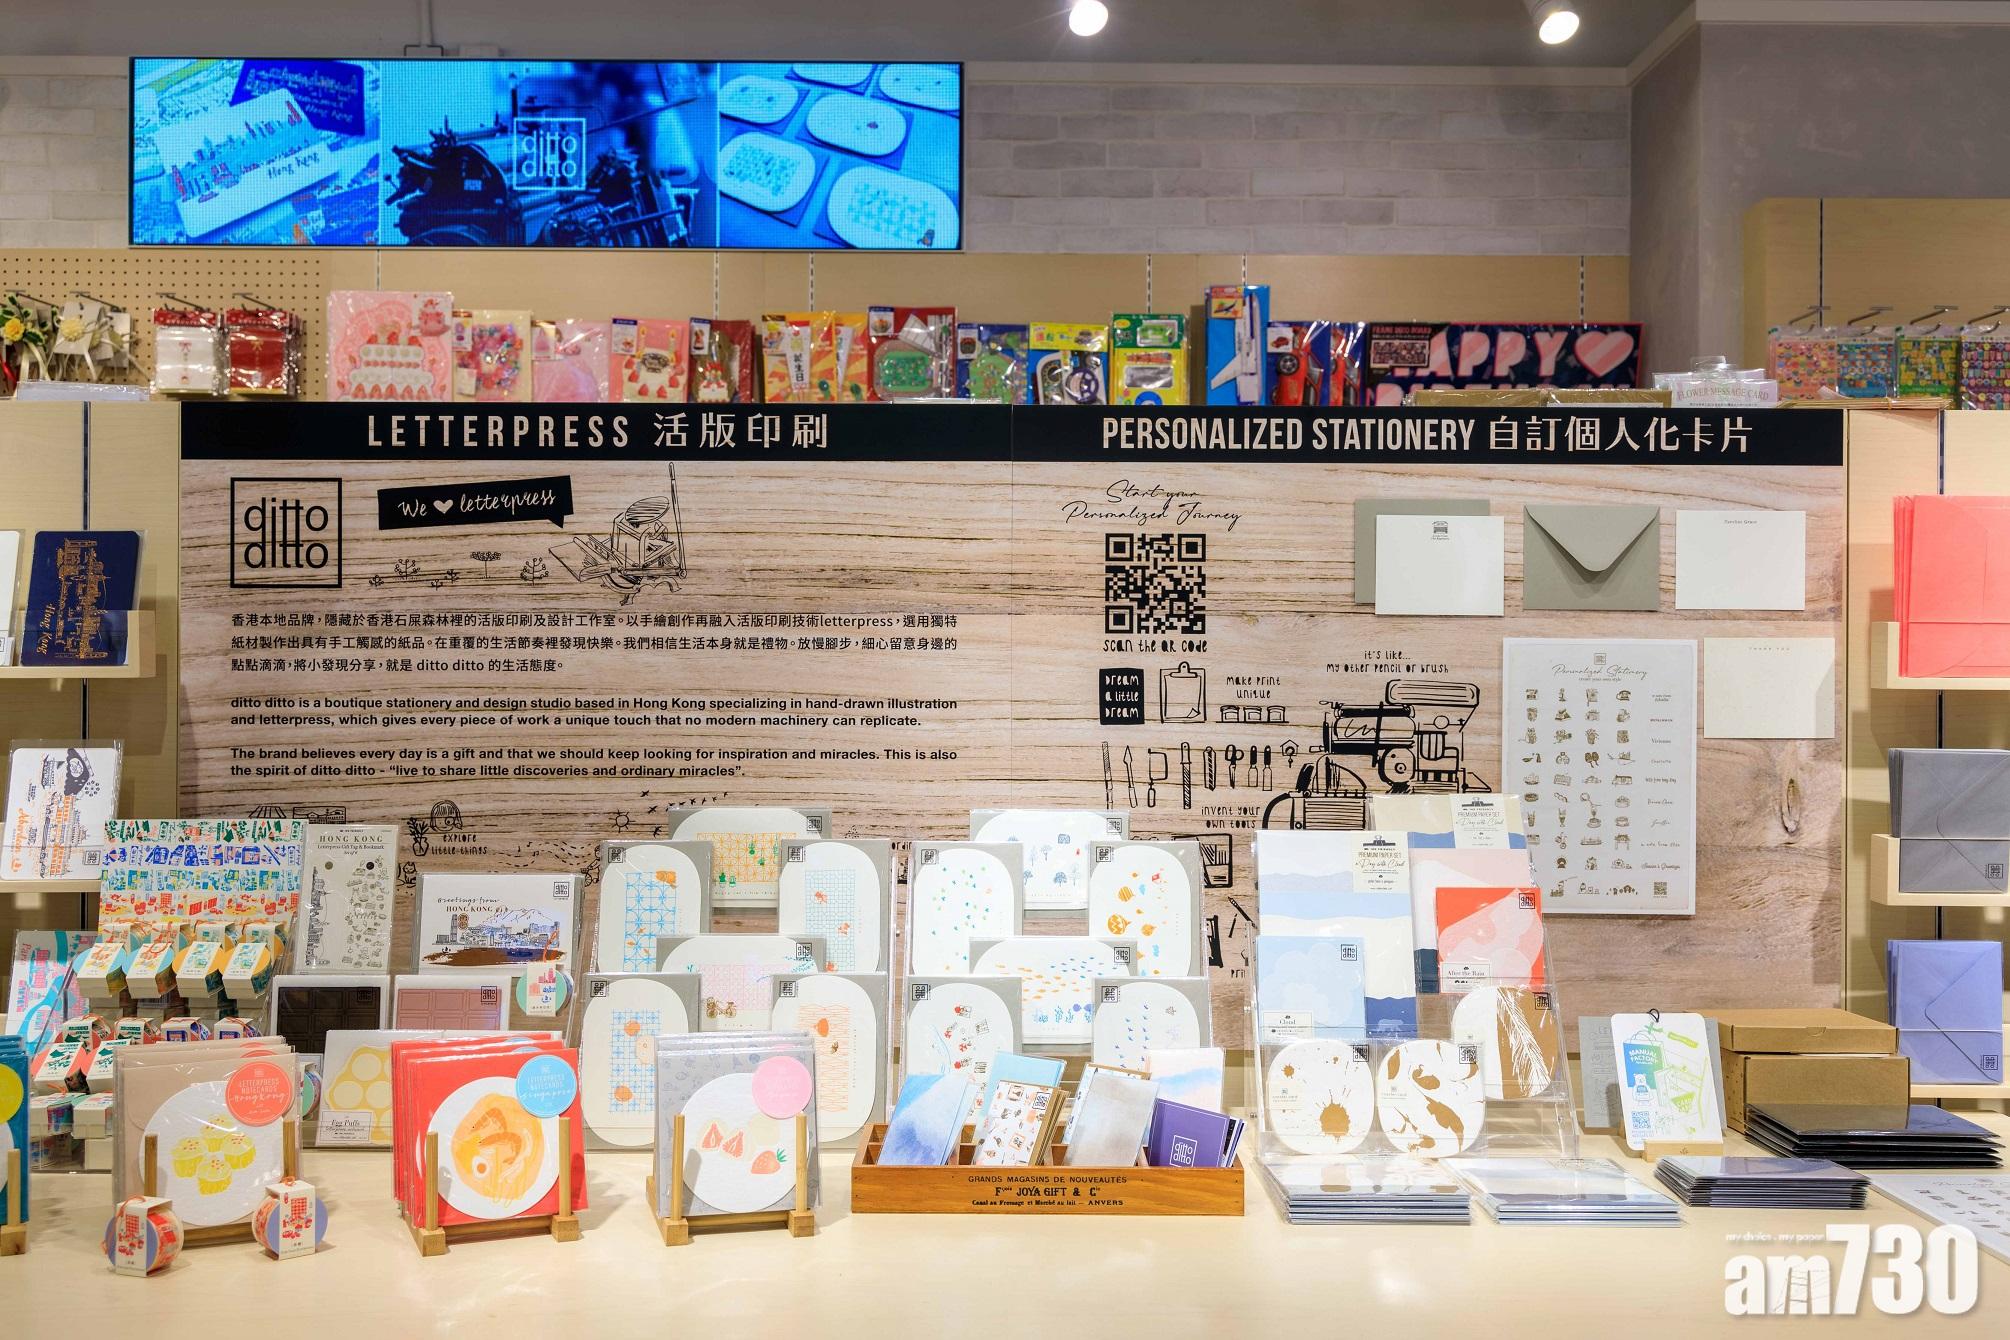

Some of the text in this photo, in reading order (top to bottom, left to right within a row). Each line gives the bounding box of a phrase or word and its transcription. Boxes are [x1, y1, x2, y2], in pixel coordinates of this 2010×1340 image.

[522, 130, 577, 153] ditto
[522, 159, 577, 177] ditto
[1677, 387, 1769, 400] FLOWER MESSAGE CARD
[368, 412, 828, 448] LETTERPRESS 活版印刷
[1103, 415, 1752, 452] PERSONALIZED STATIONERY 自訂個人化卡片
[1106, 479, 1200, 510] Start your
[398, 489, 556, 518] We letterpress
[244, 497, 329, 532] ditto
[1062, 500, 1242, 531] Personalized Journey
[244, 541, 329, 569] ditto
[1103, 640, 1133, 652] scan
[1138, 640, 1156, 652] the
[1181, 640, 1208, 652] code
[417, 659, 448, 671] ditto
[452, 659, 484, 671] ditto
[1552, 664, 1602, 678] Personalized
[1115, 691, 1139, 702] little
[230, 697, 956, 711] ditto ditto is a boutique stationery and design studio based in Hong Kong specializing in hand-drawn illustration
[231, 714, 920, 728] and letterpress, which gives every piece of work a unique touch that no modern machinery can replicate.
[230, 748, 957, 761] The brand believes every day is a gift and that we should keep looking for inspiration and miracles. This is also
[230, 765, 745, 778] the spirit of ditto ditto “live to share little discoveries and ordinary miracles”.
[319, 835, 383, 843] HONG KONG
[1016, 1186, 1081, 1197] JOYA GIFT &
